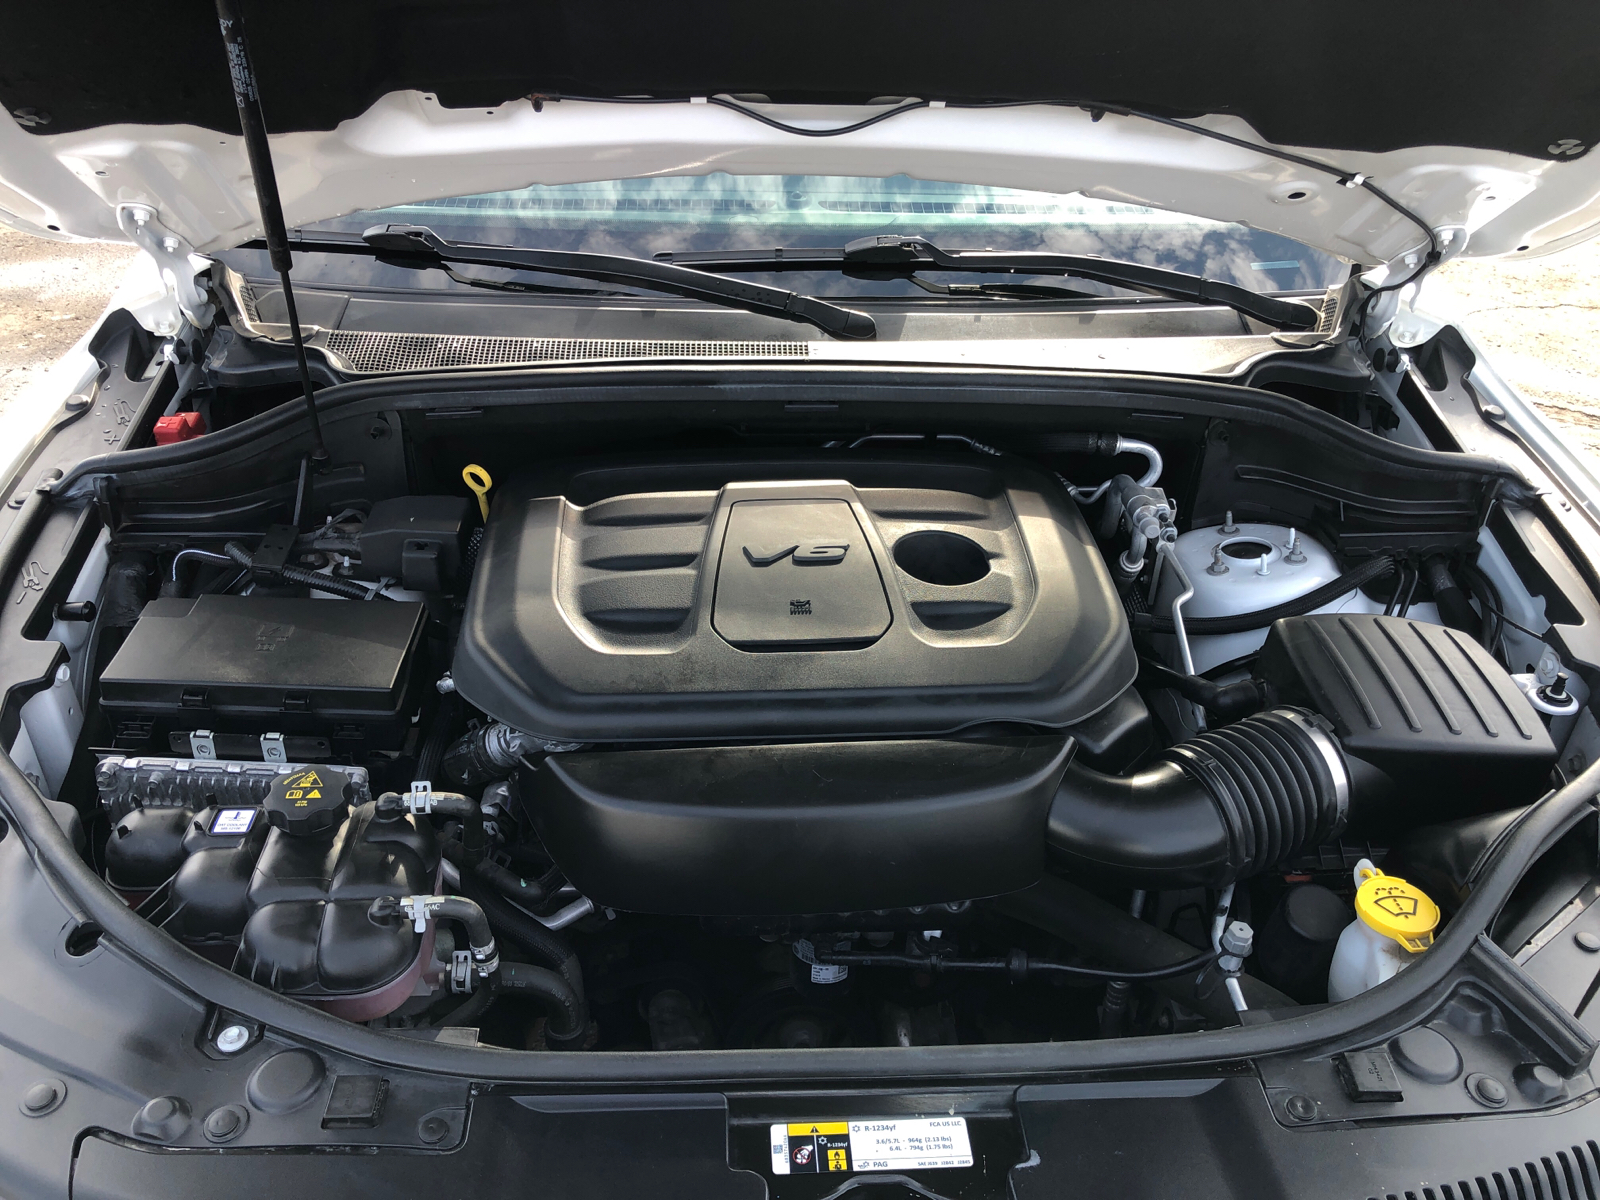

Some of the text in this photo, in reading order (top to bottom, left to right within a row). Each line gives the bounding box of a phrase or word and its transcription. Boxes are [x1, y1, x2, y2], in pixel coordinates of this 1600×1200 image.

[742, 544, 850, 567] V6
[864, 1124, 897, 1133] R-1234yf
[924, 1136, 940, 1144] (2.13
[940, 1135, 952, 1143] lbs)
